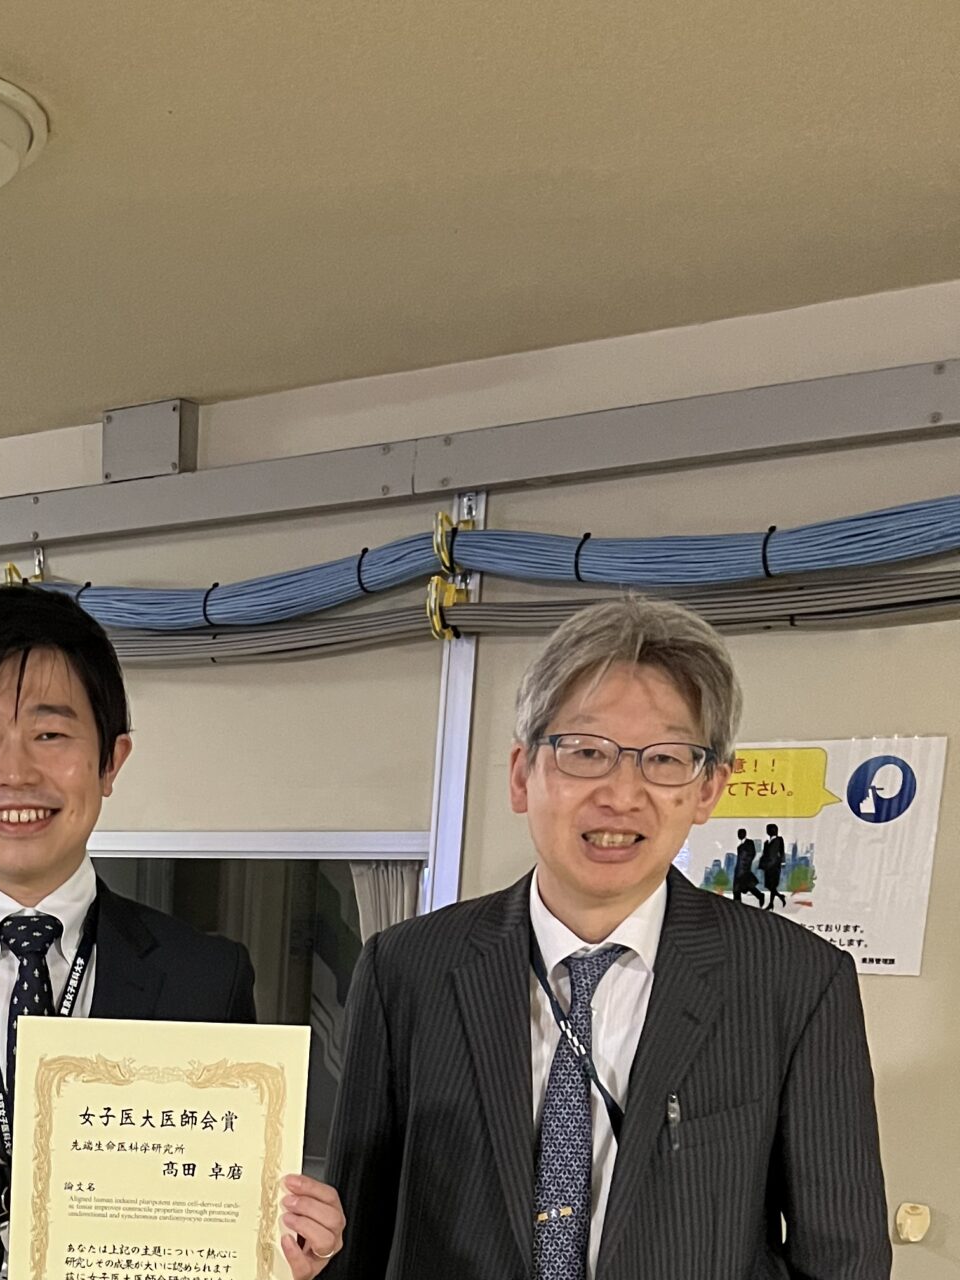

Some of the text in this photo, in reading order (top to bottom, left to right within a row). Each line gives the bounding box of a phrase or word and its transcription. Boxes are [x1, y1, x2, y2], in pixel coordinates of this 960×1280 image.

[60, 957, 86, 1016] 東京女子医科大学
[78, 1106, 239, 1133] 女子医大医師会賞
[70, 1141, 185, 1154] 先端生命医科学研究所
[63, 1181, 96, 1193] 論文名
[69, 1195, 92, 1204] Aligned
[66, 1243, 238, 1259] あなたは上記の主題について熱心に
[65, 1256, 232, 1273] 研究しその成果が大いに認められます
